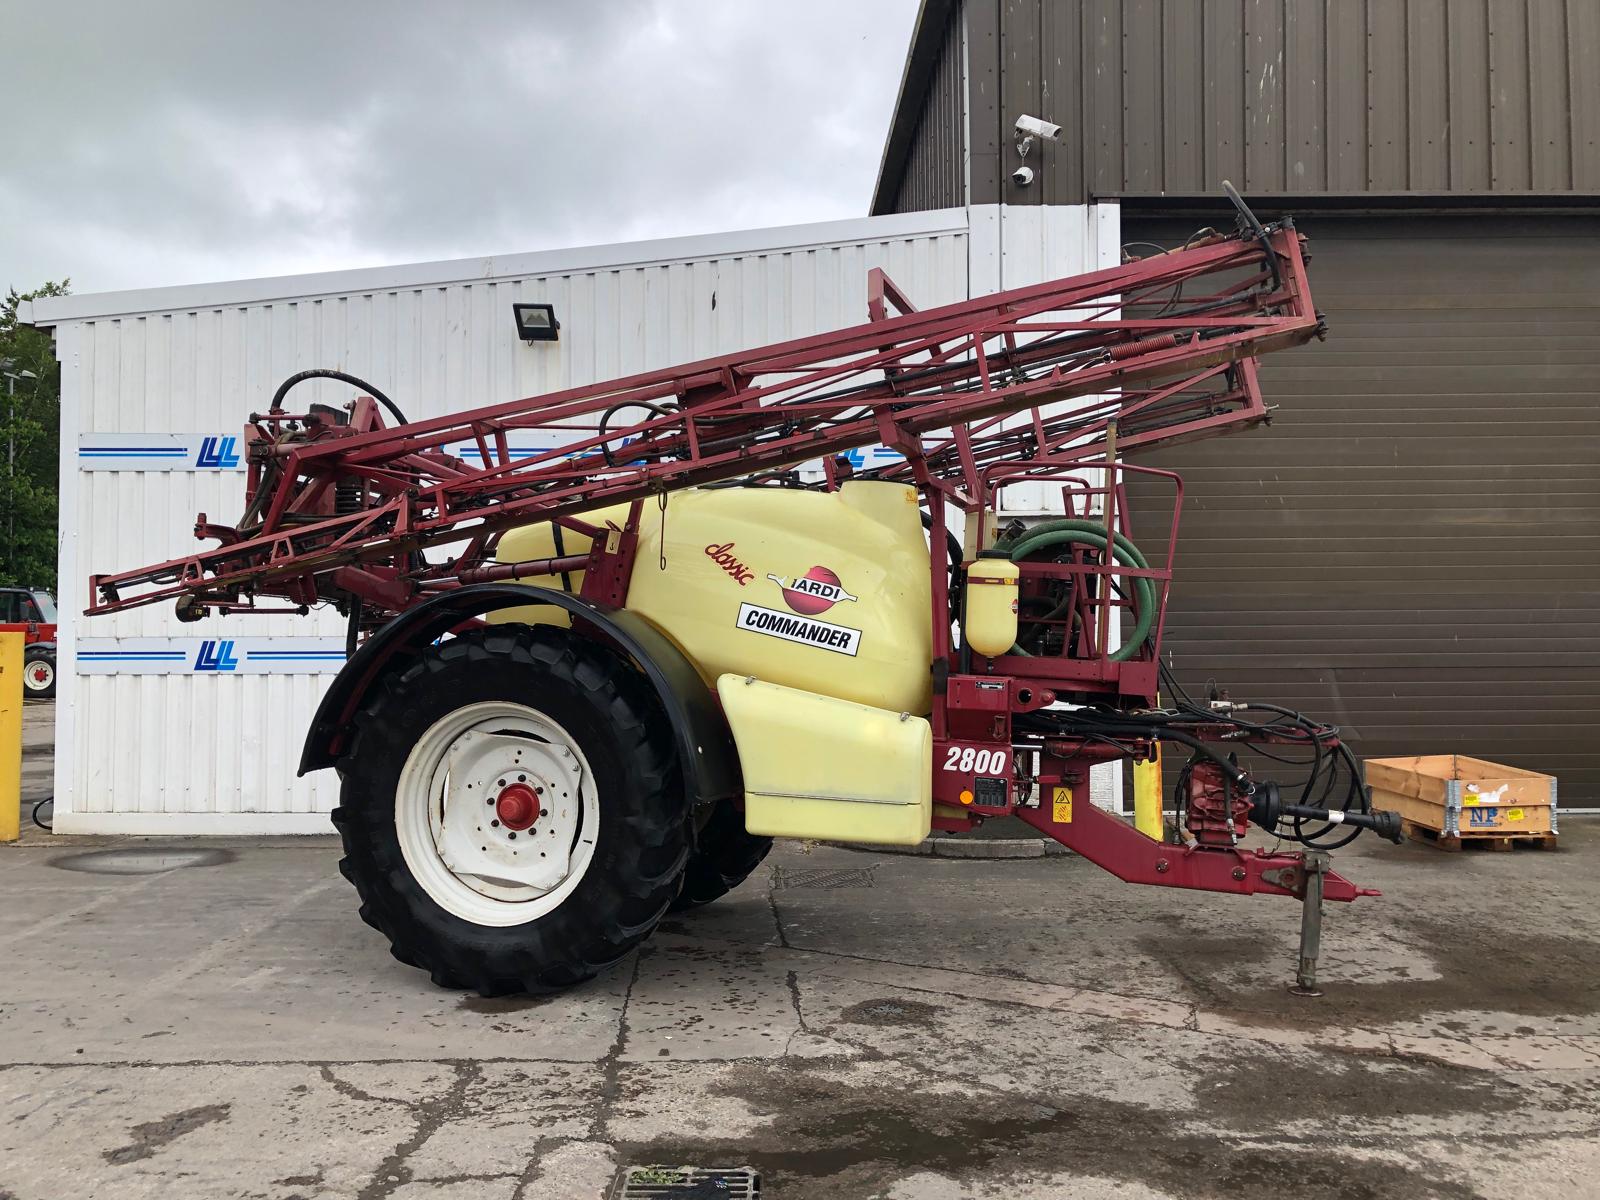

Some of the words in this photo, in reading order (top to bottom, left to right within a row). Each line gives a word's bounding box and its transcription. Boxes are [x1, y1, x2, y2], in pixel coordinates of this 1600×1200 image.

[705, 543, 754, 586] classic
[746, 610, 851, 648] COMMANDER
[943, 747, 1006, 775] 2800
